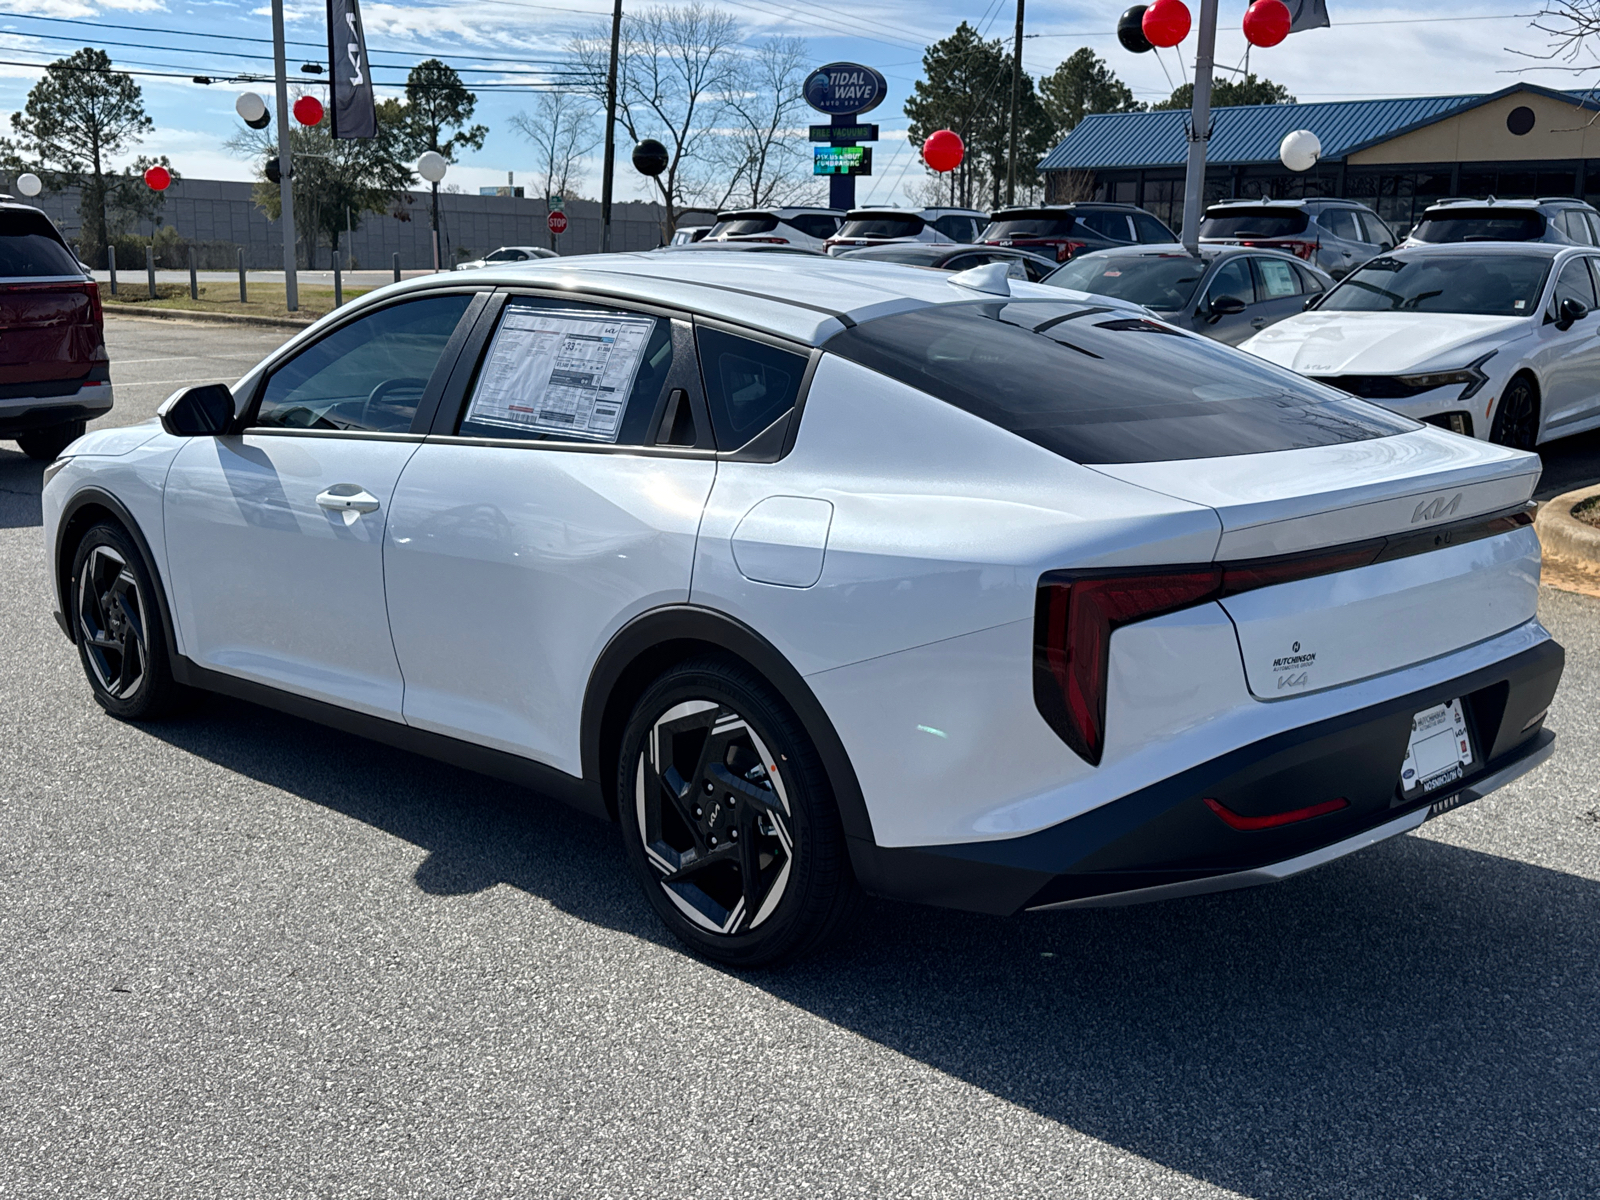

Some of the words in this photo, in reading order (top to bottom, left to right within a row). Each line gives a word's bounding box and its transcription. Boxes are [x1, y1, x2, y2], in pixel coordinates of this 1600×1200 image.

[830, 72, 865, 85] TIDAL
[835, 86, 872, 99] WAVE
[811, 128, 831, 137] FREE
[832, 127, 869, 137] VACUUMS
[549, 218, 567, 228] STOP
[565, 342, 576, 351] 33
[1411, 493, 1463, 523] KIA
[1272, 652, 1317, 667] HUTCHINSON
[1273, 663, 1300, 672] AUTOMOTIVE
[1277, 671, 1309, 690] K4
[1455, 727, 1467, 738] KIA
